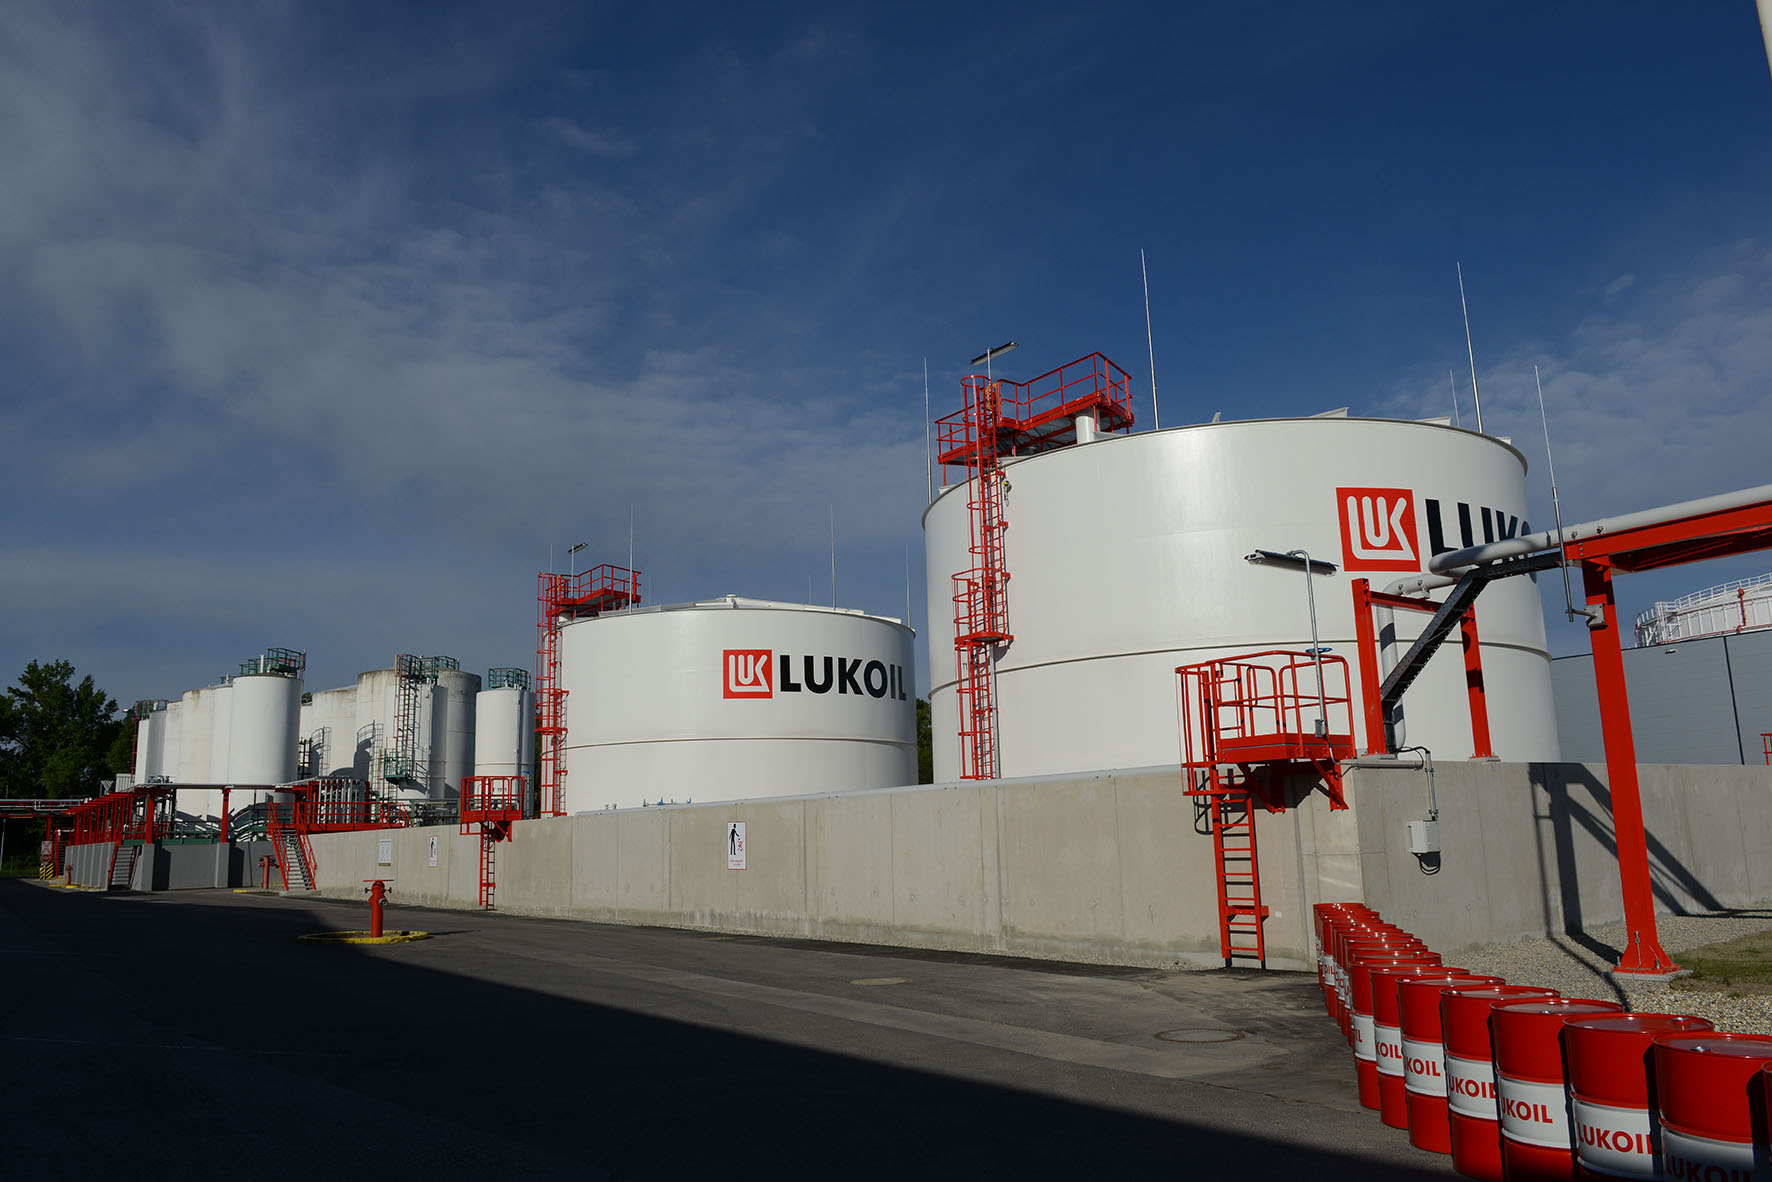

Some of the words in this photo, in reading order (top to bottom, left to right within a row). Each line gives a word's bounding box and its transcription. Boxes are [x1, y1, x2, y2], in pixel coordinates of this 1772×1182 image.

[1425, 498, 1534, 566] LUK
[779, 654, 907, 702] LUKOIL
[1404, 1056, 1441, 1078] KOIL
[1577, 1121, 1658, 1156] LUKOIL
